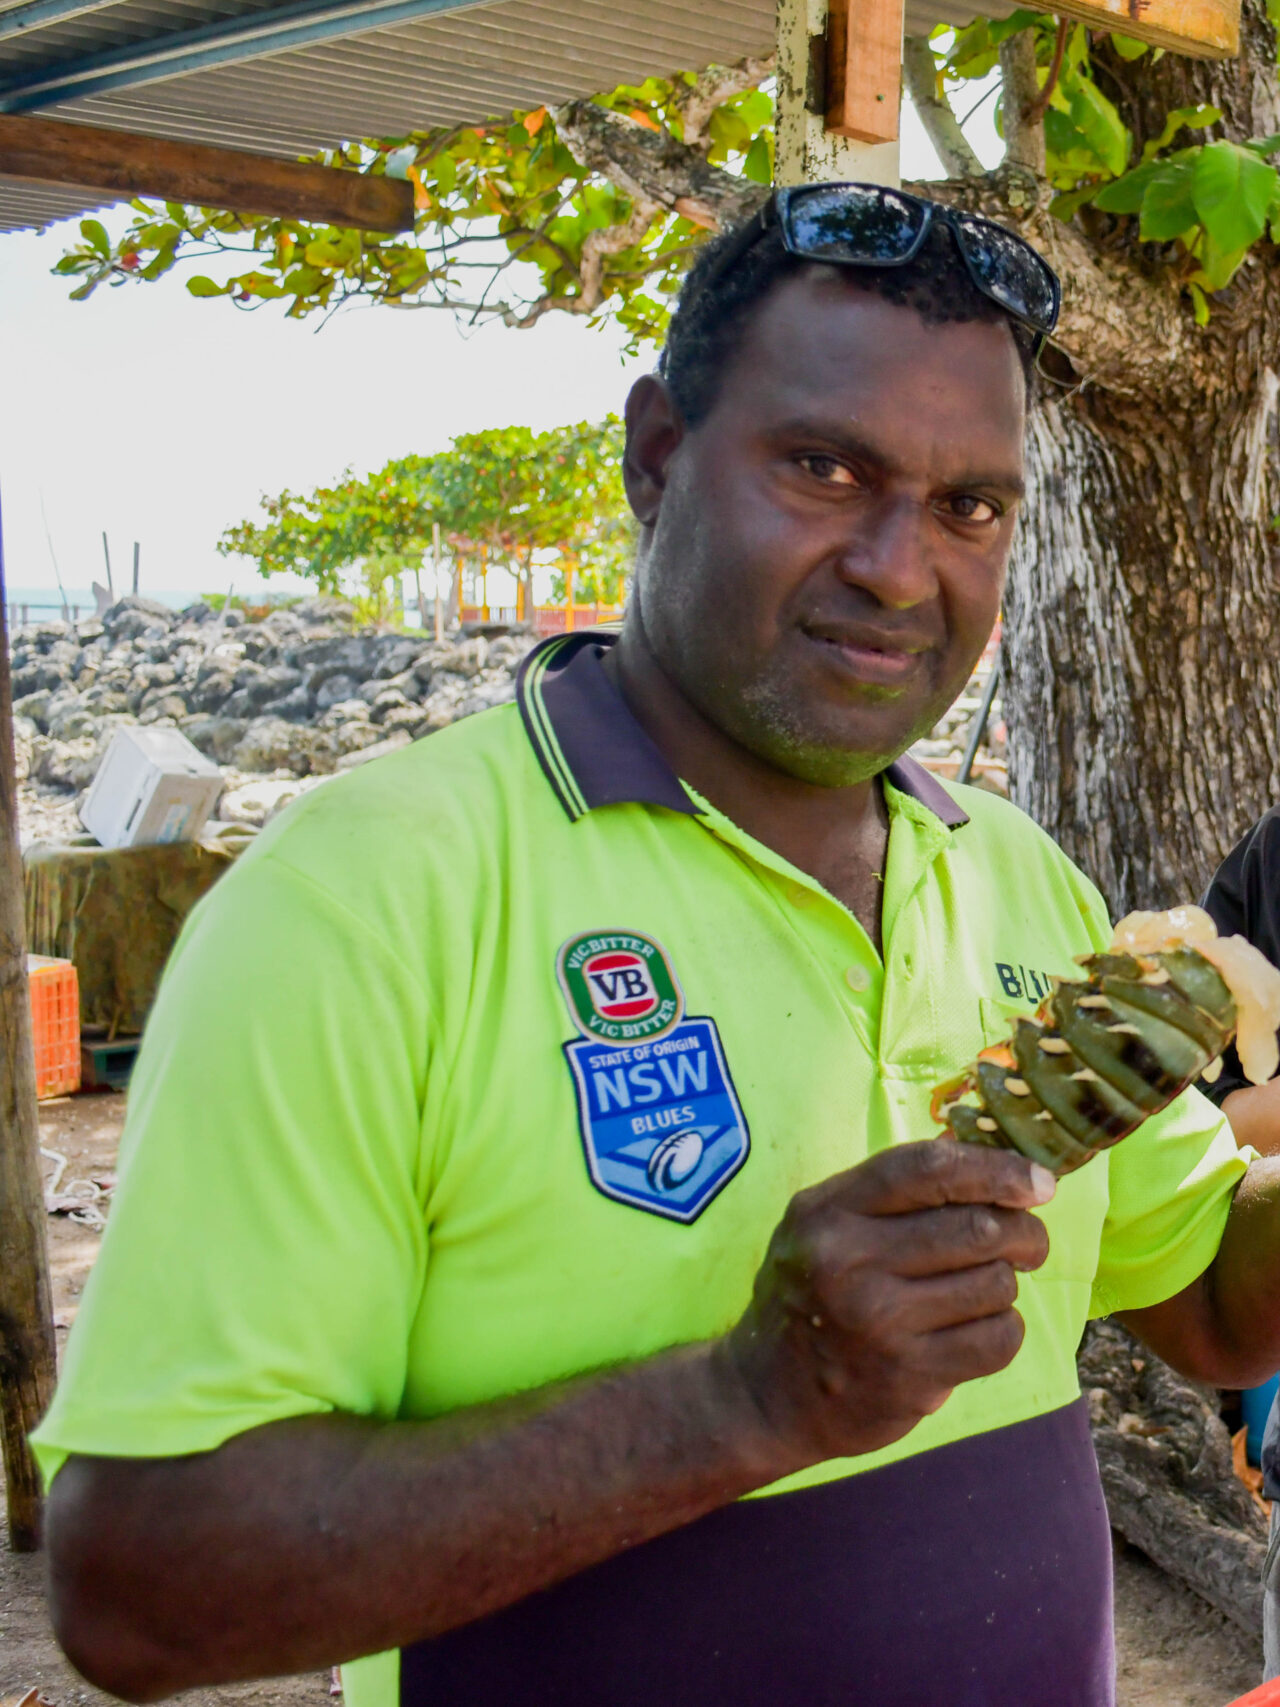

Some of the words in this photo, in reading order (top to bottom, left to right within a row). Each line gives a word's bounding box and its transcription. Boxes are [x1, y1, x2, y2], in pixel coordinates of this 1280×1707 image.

[567, 944, 590, 969] VIC
[587, 937, 655, 958] BITTER
[589, 968, 648, 1001] VB
[589, 1014, 619, 1037] VIC
[620, 999, 675, 1038] BITTER
[588, 1050, 632, 1069] STATE
[633, 1045, 651, 1061] OF
[653, 1036, 699, 1055] ORIGIN
[592, 1050, 709, 1113] NSW
[631, 1105, 696, 1135] BLUES
